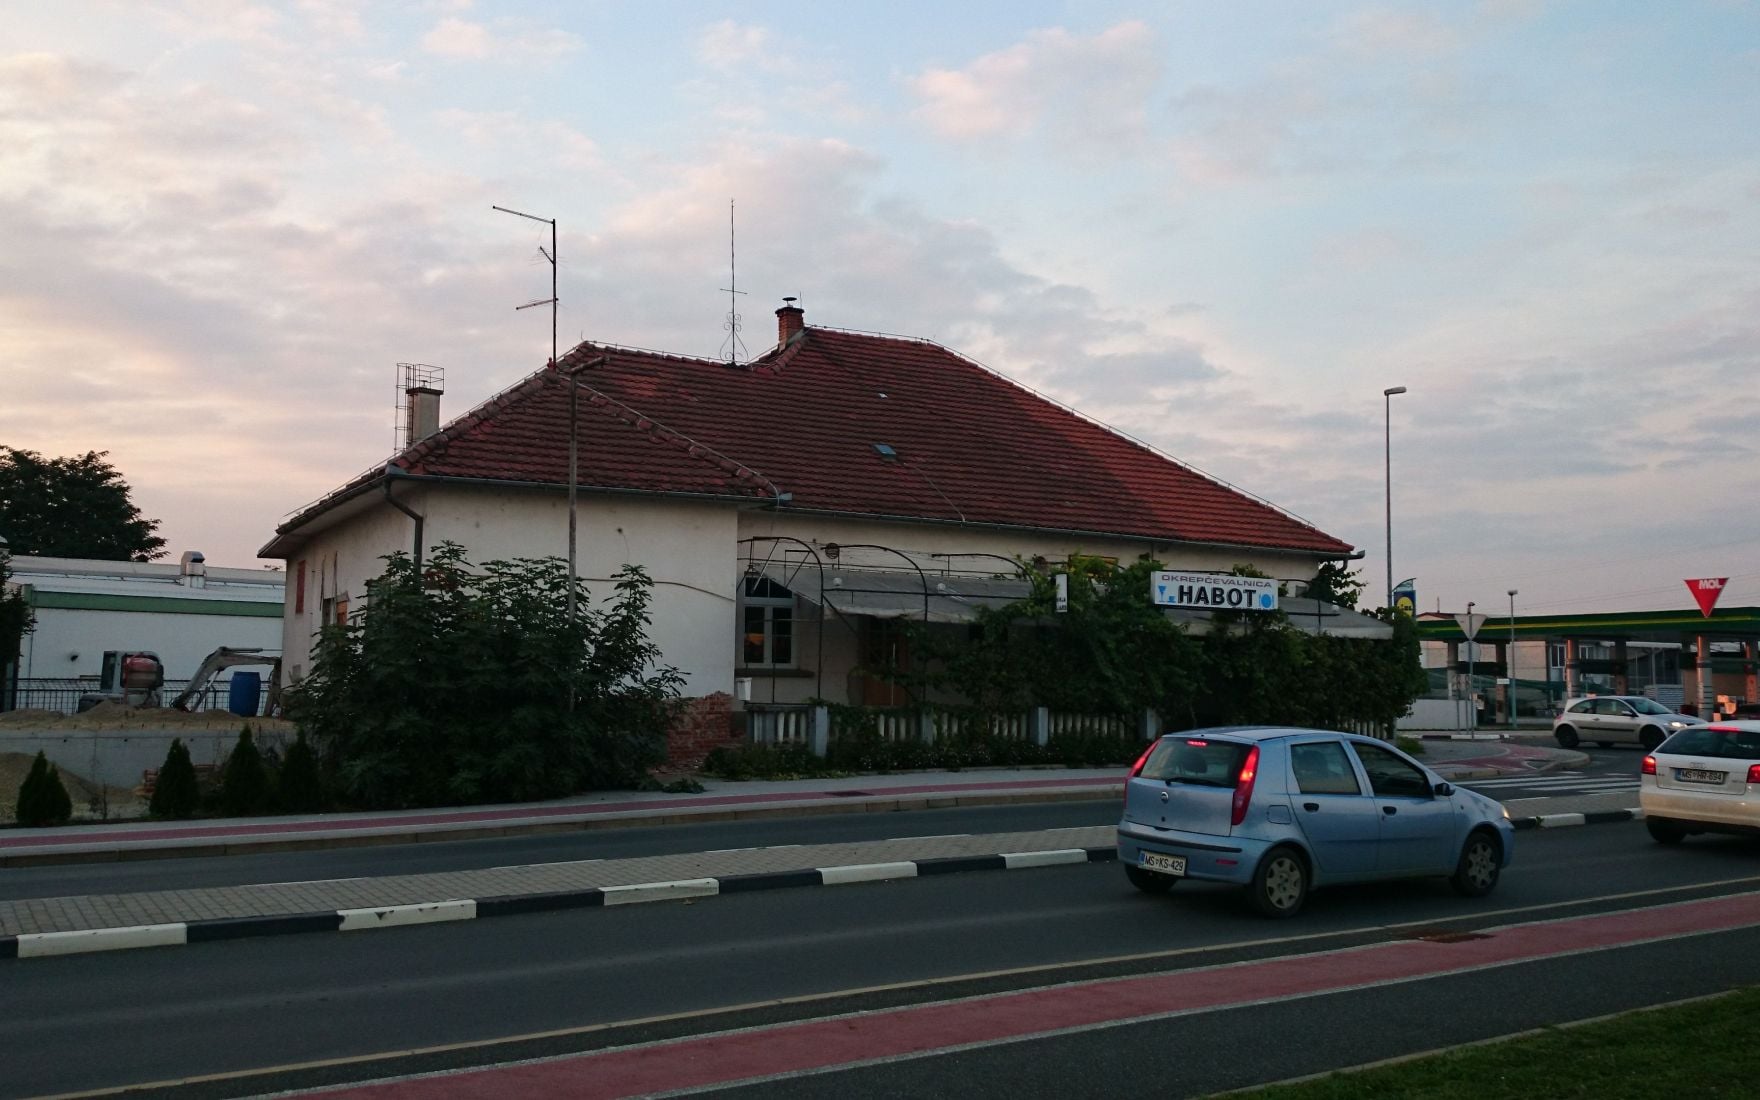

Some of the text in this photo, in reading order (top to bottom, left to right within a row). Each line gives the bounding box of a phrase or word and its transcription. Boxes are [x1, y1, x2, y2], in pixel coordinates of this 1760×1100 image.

[1161, 574, 1272, 588] OKREPČEVALNICA
[1698, 579, 1723, 590] MOL
[1177, 584, 1257, 608] HABOT
[1144, 854, 1184, 872] MS KS-429
